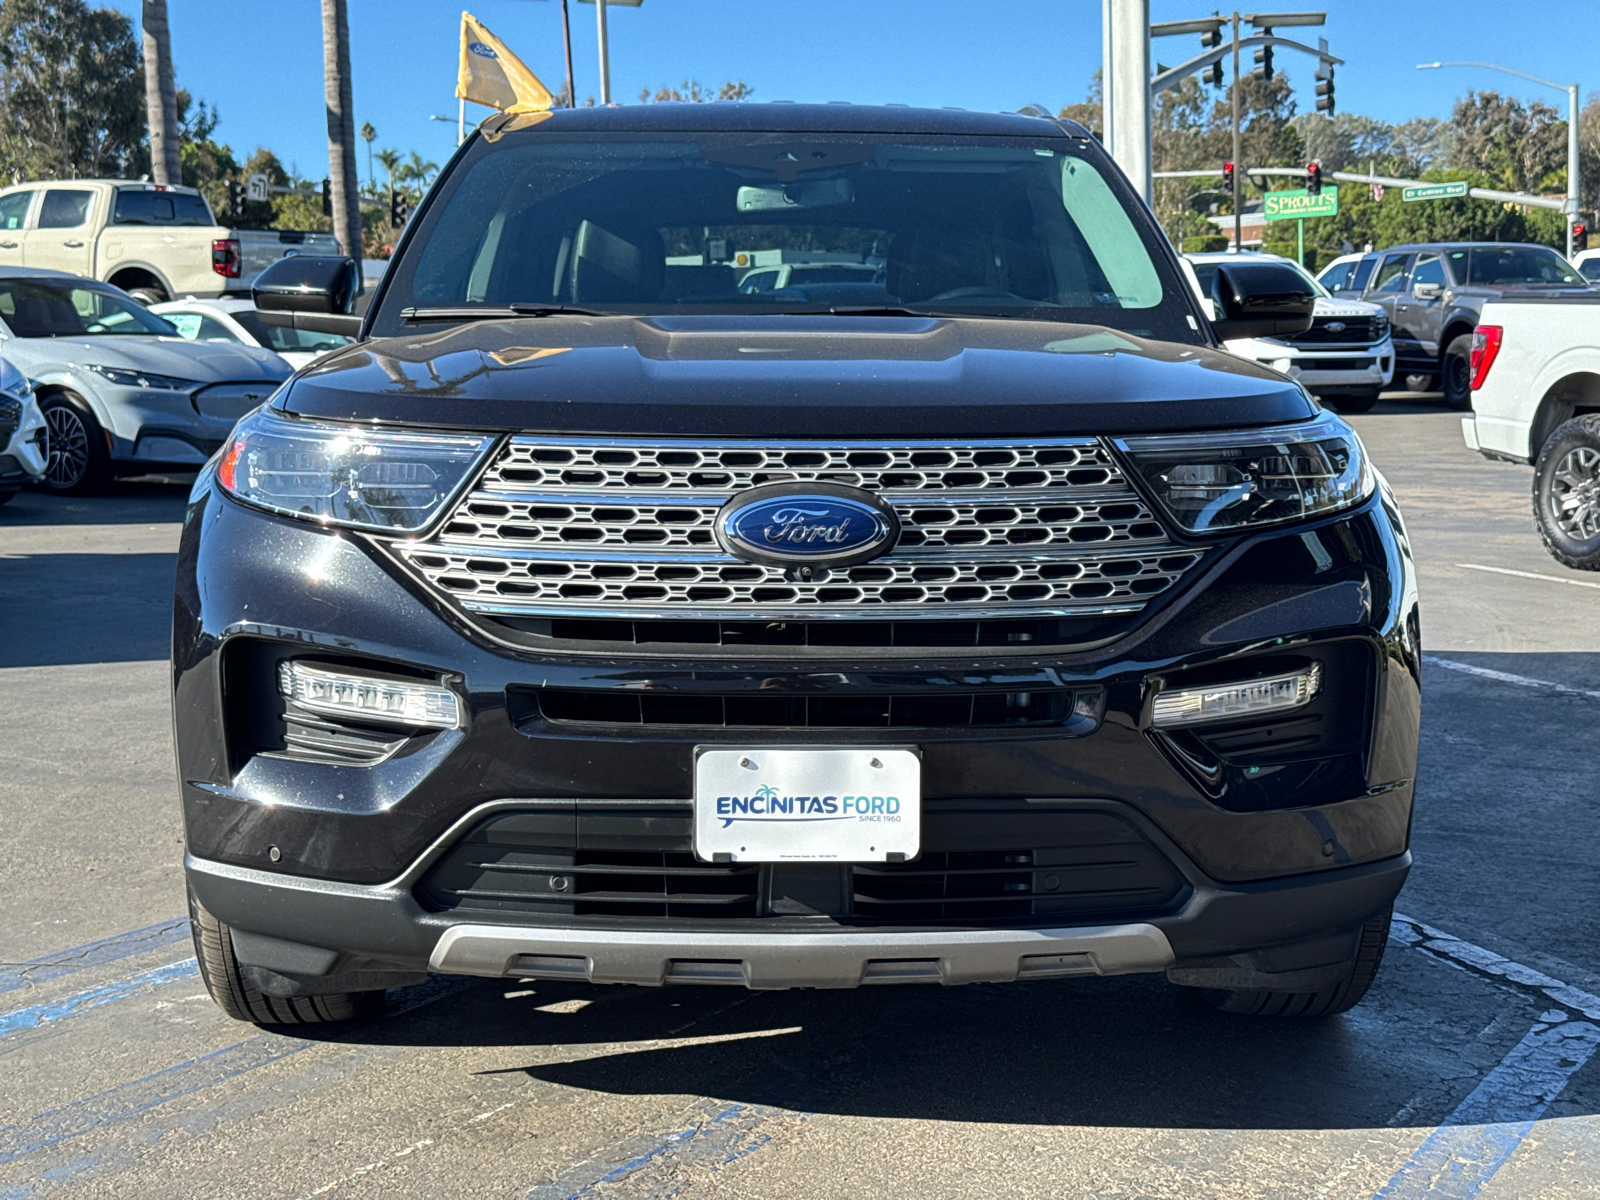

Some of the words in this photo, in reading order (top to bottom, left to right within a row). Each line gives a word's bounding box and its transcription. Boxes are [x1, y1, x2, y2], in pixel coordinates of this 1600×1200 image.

[473, 43, 496, 57] Ford
[1266, 193, 1335, 215] SPROUTS
[764, 507, 852, 544] Ford
[716, 796, 839, 814] ENCINITAS
[843, 796, 900, 814] FORD
